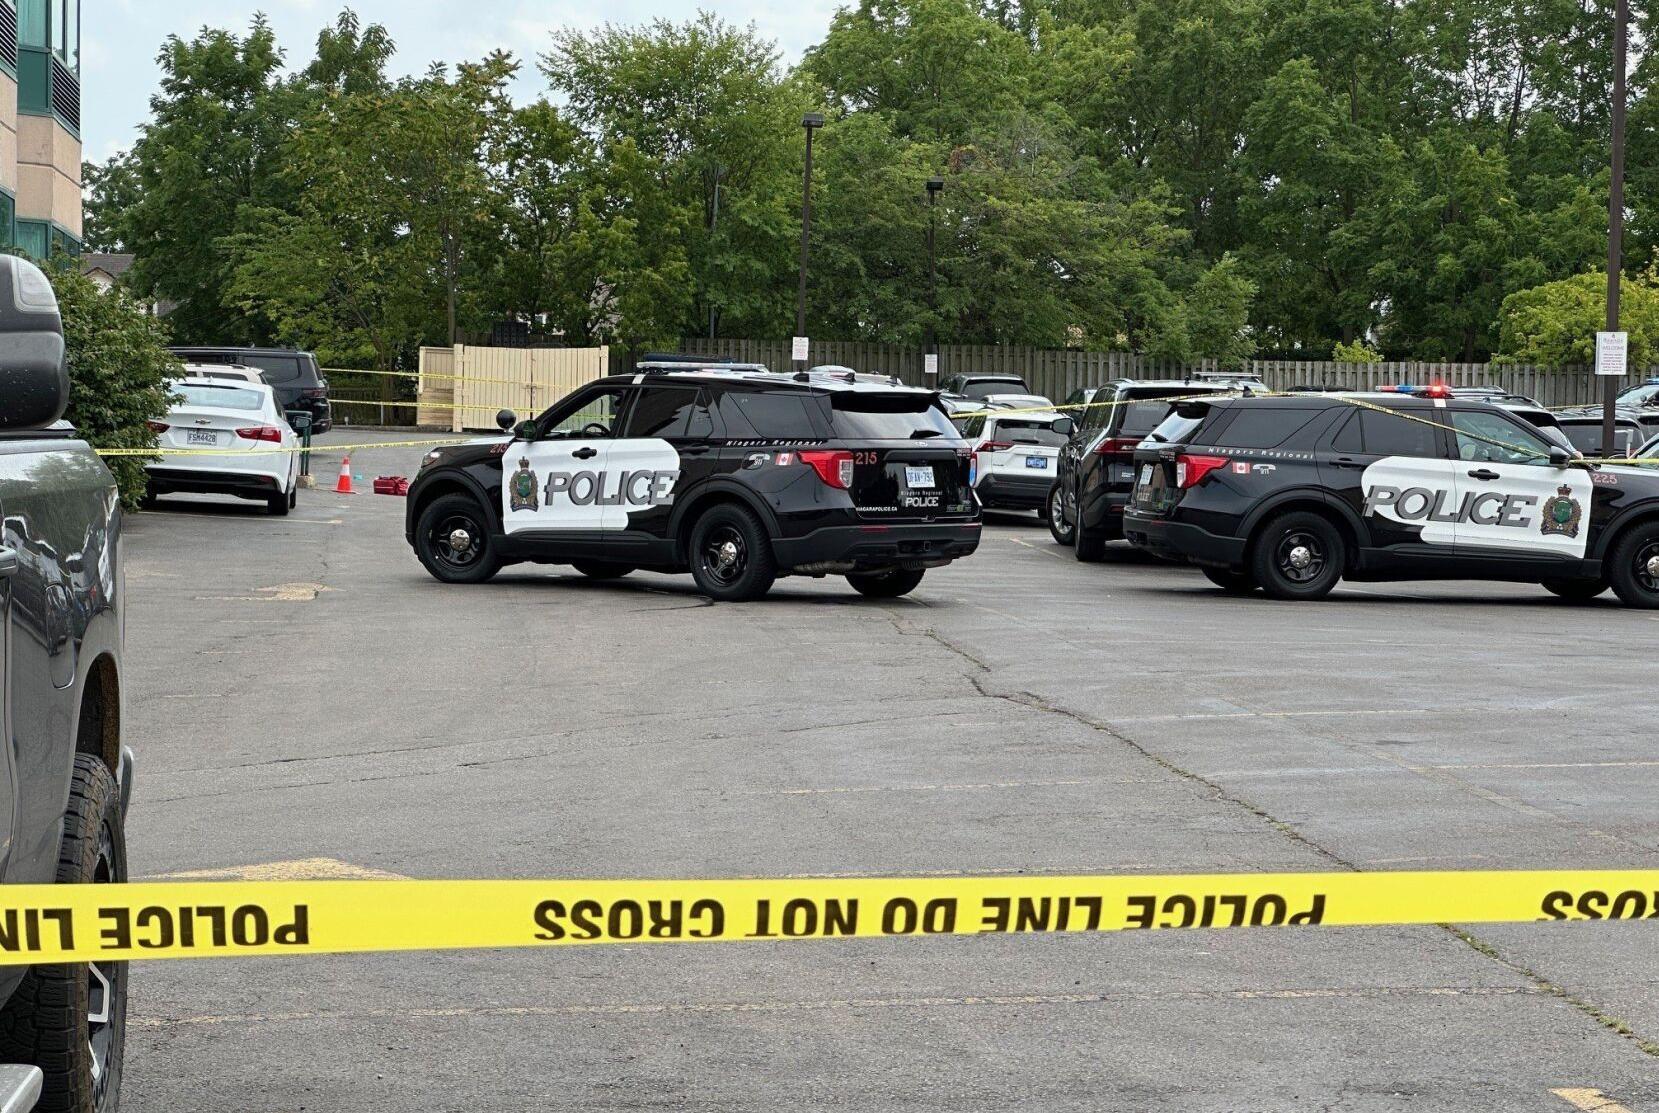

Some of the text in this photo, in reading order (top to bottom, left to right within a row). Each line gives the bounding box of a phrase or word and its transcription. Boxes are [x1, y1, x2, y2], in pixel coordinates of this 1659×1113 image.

[772, 439, 823, 447] Regional
[855, 452, 878, 465] 215
[1208, 447, 1314, 460] Niagara Regional
[1593, 473, 1618, 485] 225
[544, 470, 681, 506] POLICE
[905, 496, 939, 508] POLICE
[1362, 485, 1538, 528] POLICE
[533, 893, 1326, 940] POLICE LINE DO NOT CROSS
[98, 904, 310, 950] POLICE
